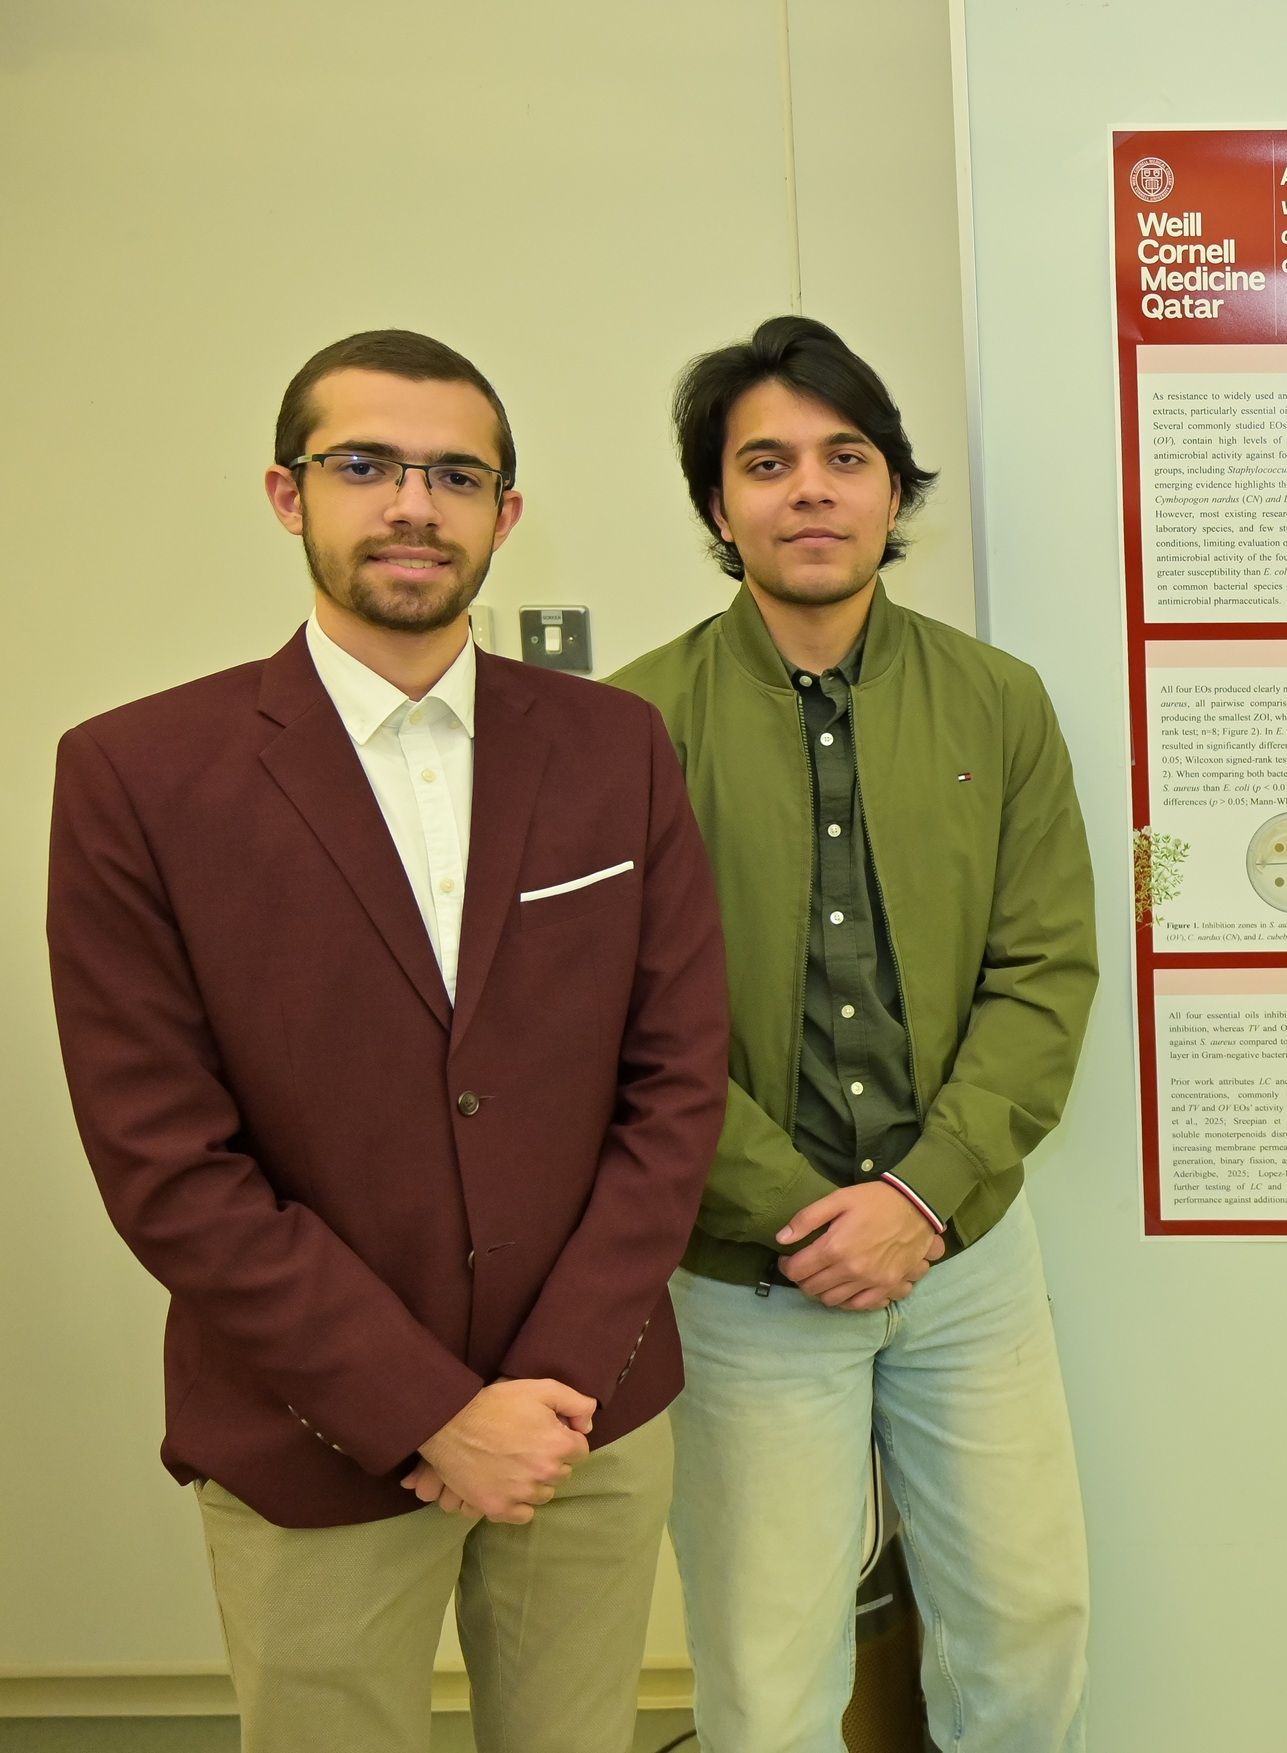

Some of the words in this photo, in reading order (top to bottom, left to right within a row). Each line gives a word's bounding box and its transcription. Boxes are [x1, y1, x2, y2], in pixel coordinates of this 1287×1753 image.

[1137, 212, 1202, 237] Weill
[1138, 239, 1235, 264] Cornell
[1141, 266, 1265, 291] Medicine
[1142, 293, 1224, 320] Qatar
[1154, 451, 1208, 459] antimicrobial
[1212, 451, 1242, 461] activity
[1246, 450, 1274, 461] against
[1156, 510, 1194, 519] However,
[1224, 509, 1257, 520] existing
[1156, 524, 1197, 535] laboratory
[1202, 524, 1234, 534] species,
[1239, 524, 1254, 532] and
[1259, 524, 1274, 532] few
[1195, 699, 1205, 707] all
[1210, 699, 1244, 709] pairwise
[1170, 1092, 1230, 1100] concentrations,
[1238, 1090, 1279, 1100] commonly
[1174, 1196, 1222, 1205] performance
[1224, 1195, 1251, 1205] against
